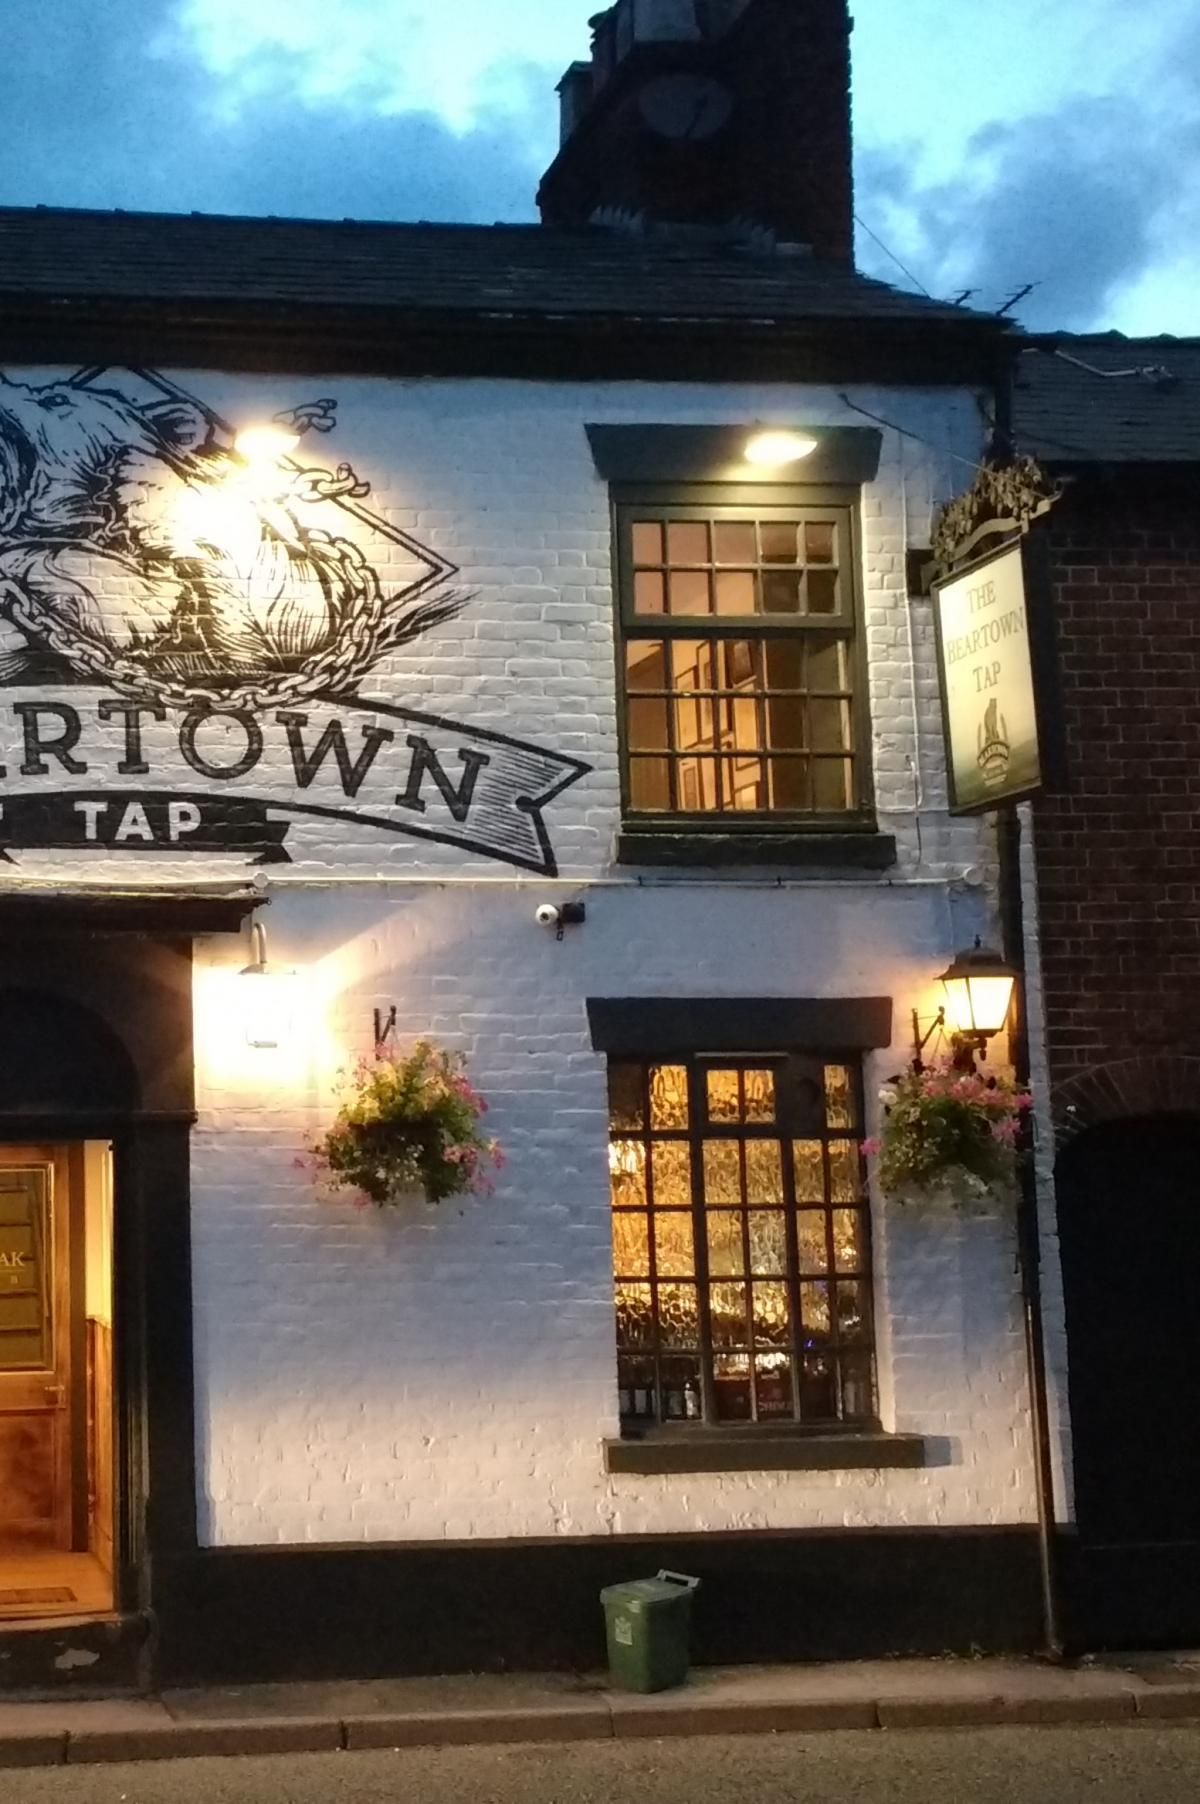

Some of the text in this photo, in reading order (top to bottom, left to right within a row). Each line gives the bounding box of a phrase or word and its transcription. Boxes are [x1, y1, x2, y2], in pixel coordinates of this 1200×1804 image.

[966, 580, 997, 614] THE
[945, 606, 1025, 665] BEARTOWN
[972, 660, 1002, 693] TAP
[74, 801, 202, 846] TAP
